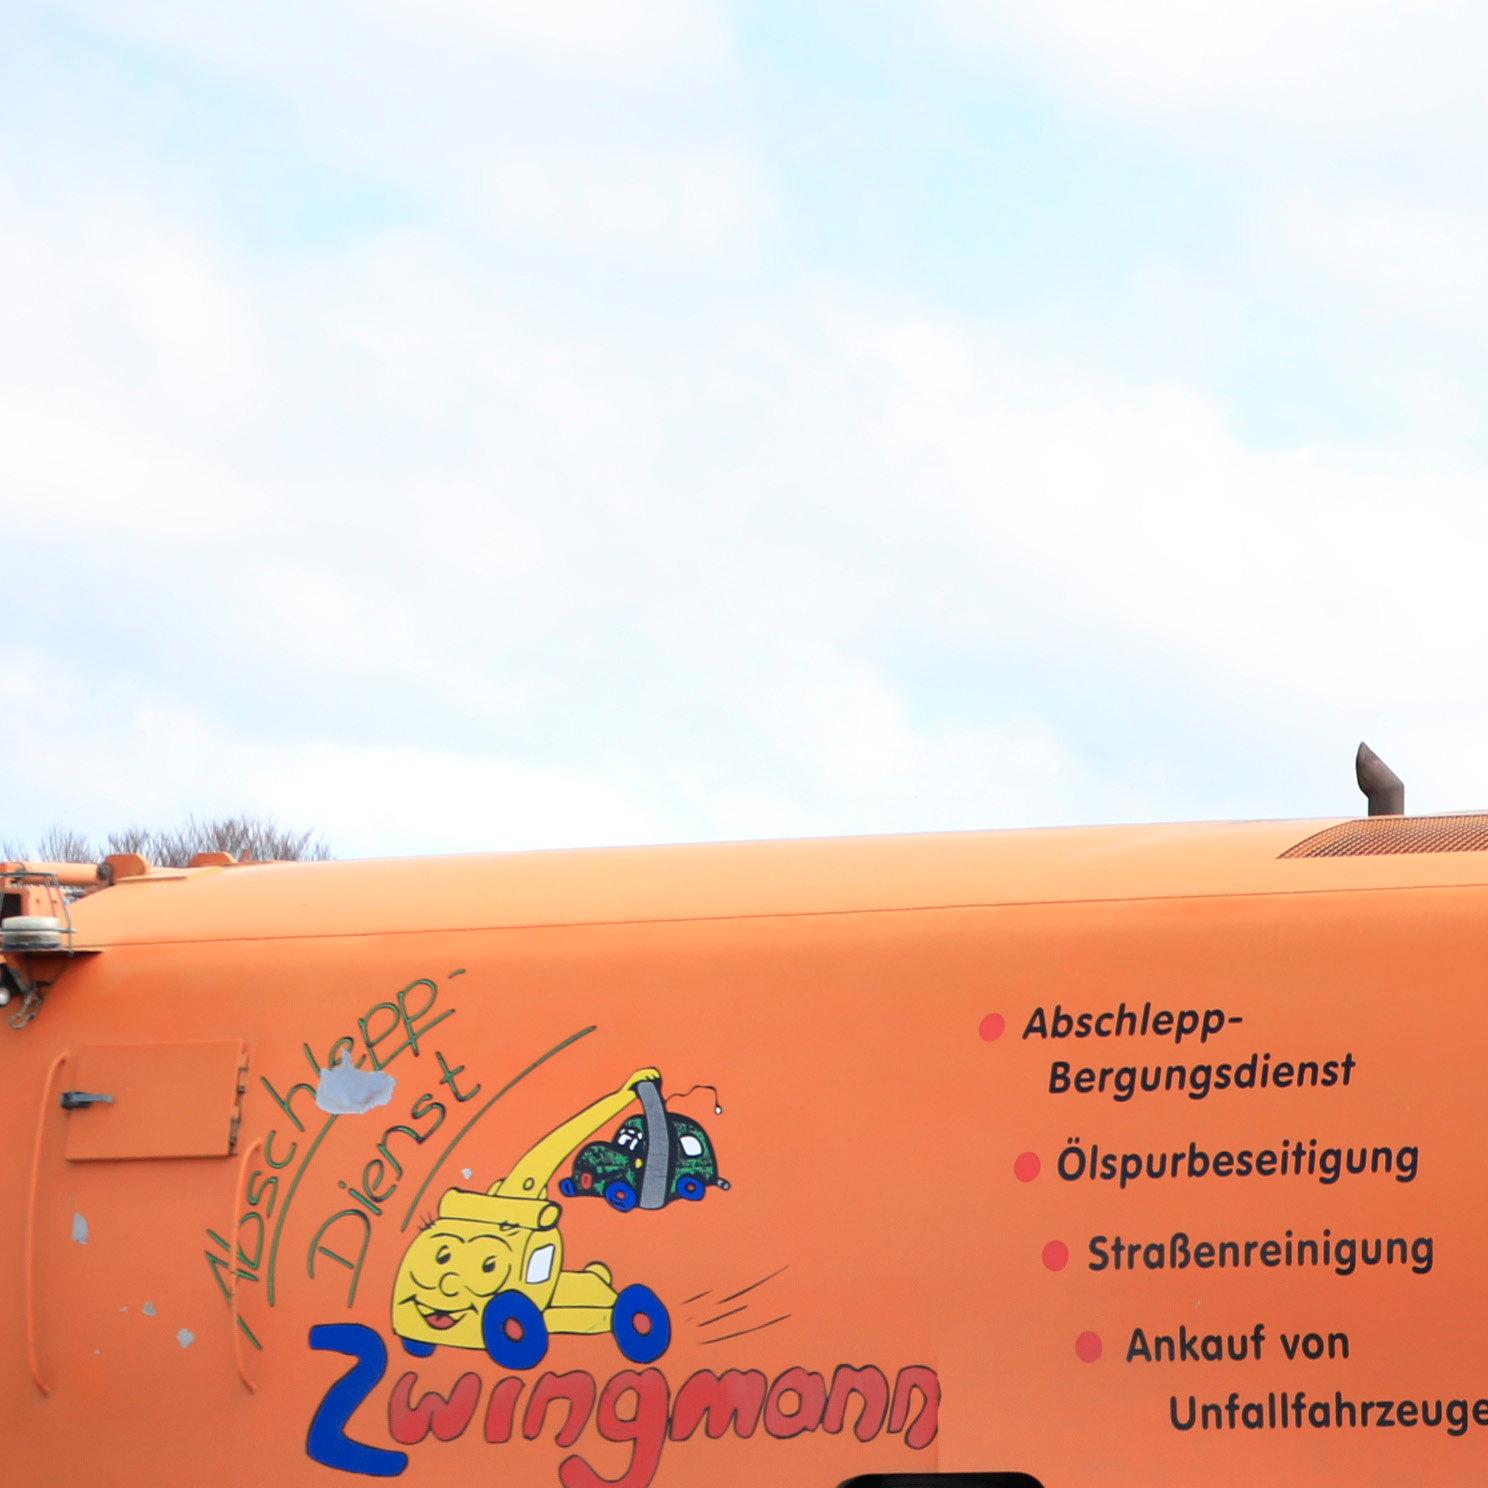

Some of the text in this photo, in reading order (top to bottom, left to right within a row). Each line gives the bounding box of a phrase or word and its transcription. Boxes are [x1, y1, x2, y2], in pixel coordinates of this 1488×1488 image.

[1022, 1002, 1244, 1044] Abschlepp-
[1048, 1052, 1355, 1101] Bergungsdienst
[308, 1051, 481, 1308] Dienst
[1057, 1136, 1420, 1188] Ölspurbeseitigung
[1089, 1229, 1435, 1275] Straßenreinigung
[1126, 1323, 1350, 1363] Ankauf von
